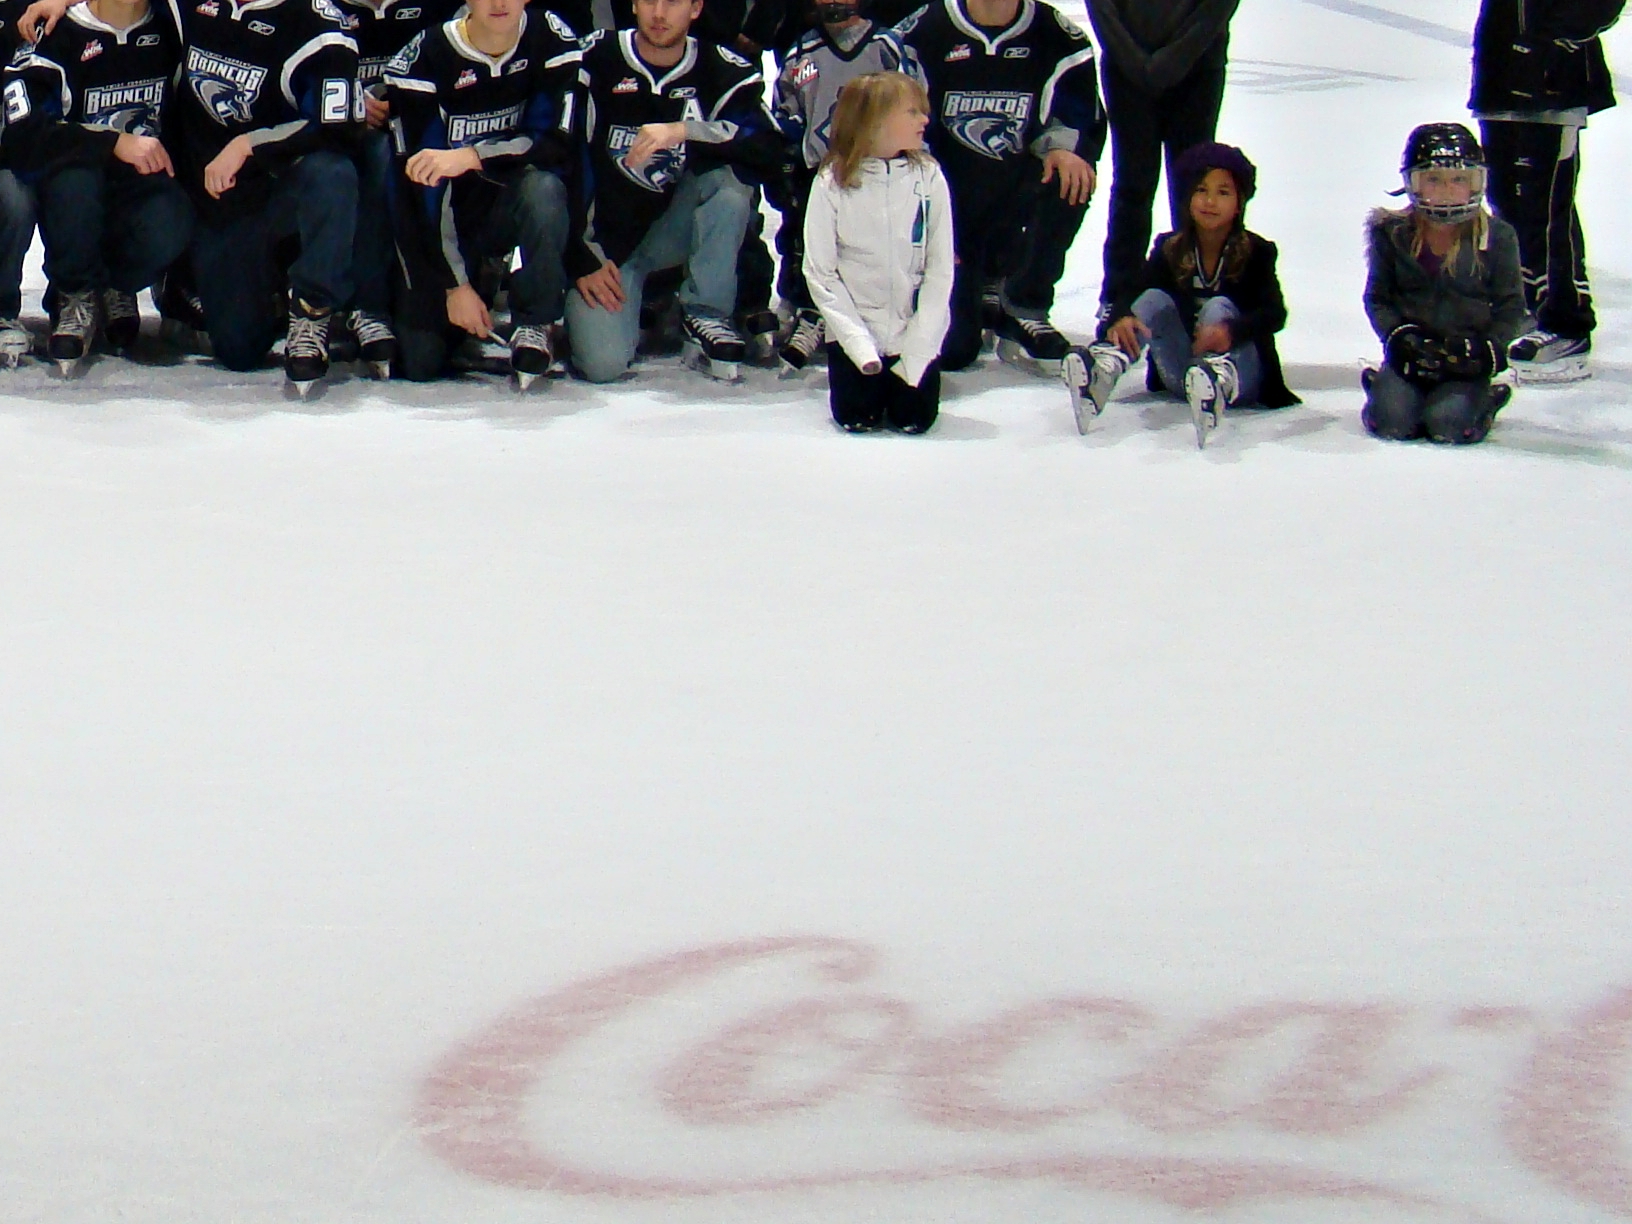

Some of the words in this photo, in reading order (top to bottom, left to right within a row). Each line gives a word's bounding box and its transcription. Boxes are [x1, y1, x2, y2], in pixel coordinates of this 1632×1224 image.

[189, 49, 267, 93] BRONCOS
[4, 80, 32, 124] 3
[86, 82, 165, 114] BRONCOS
[681, 98, 704, 122] A
[944, 95, 1029, 118] BRONCOS
